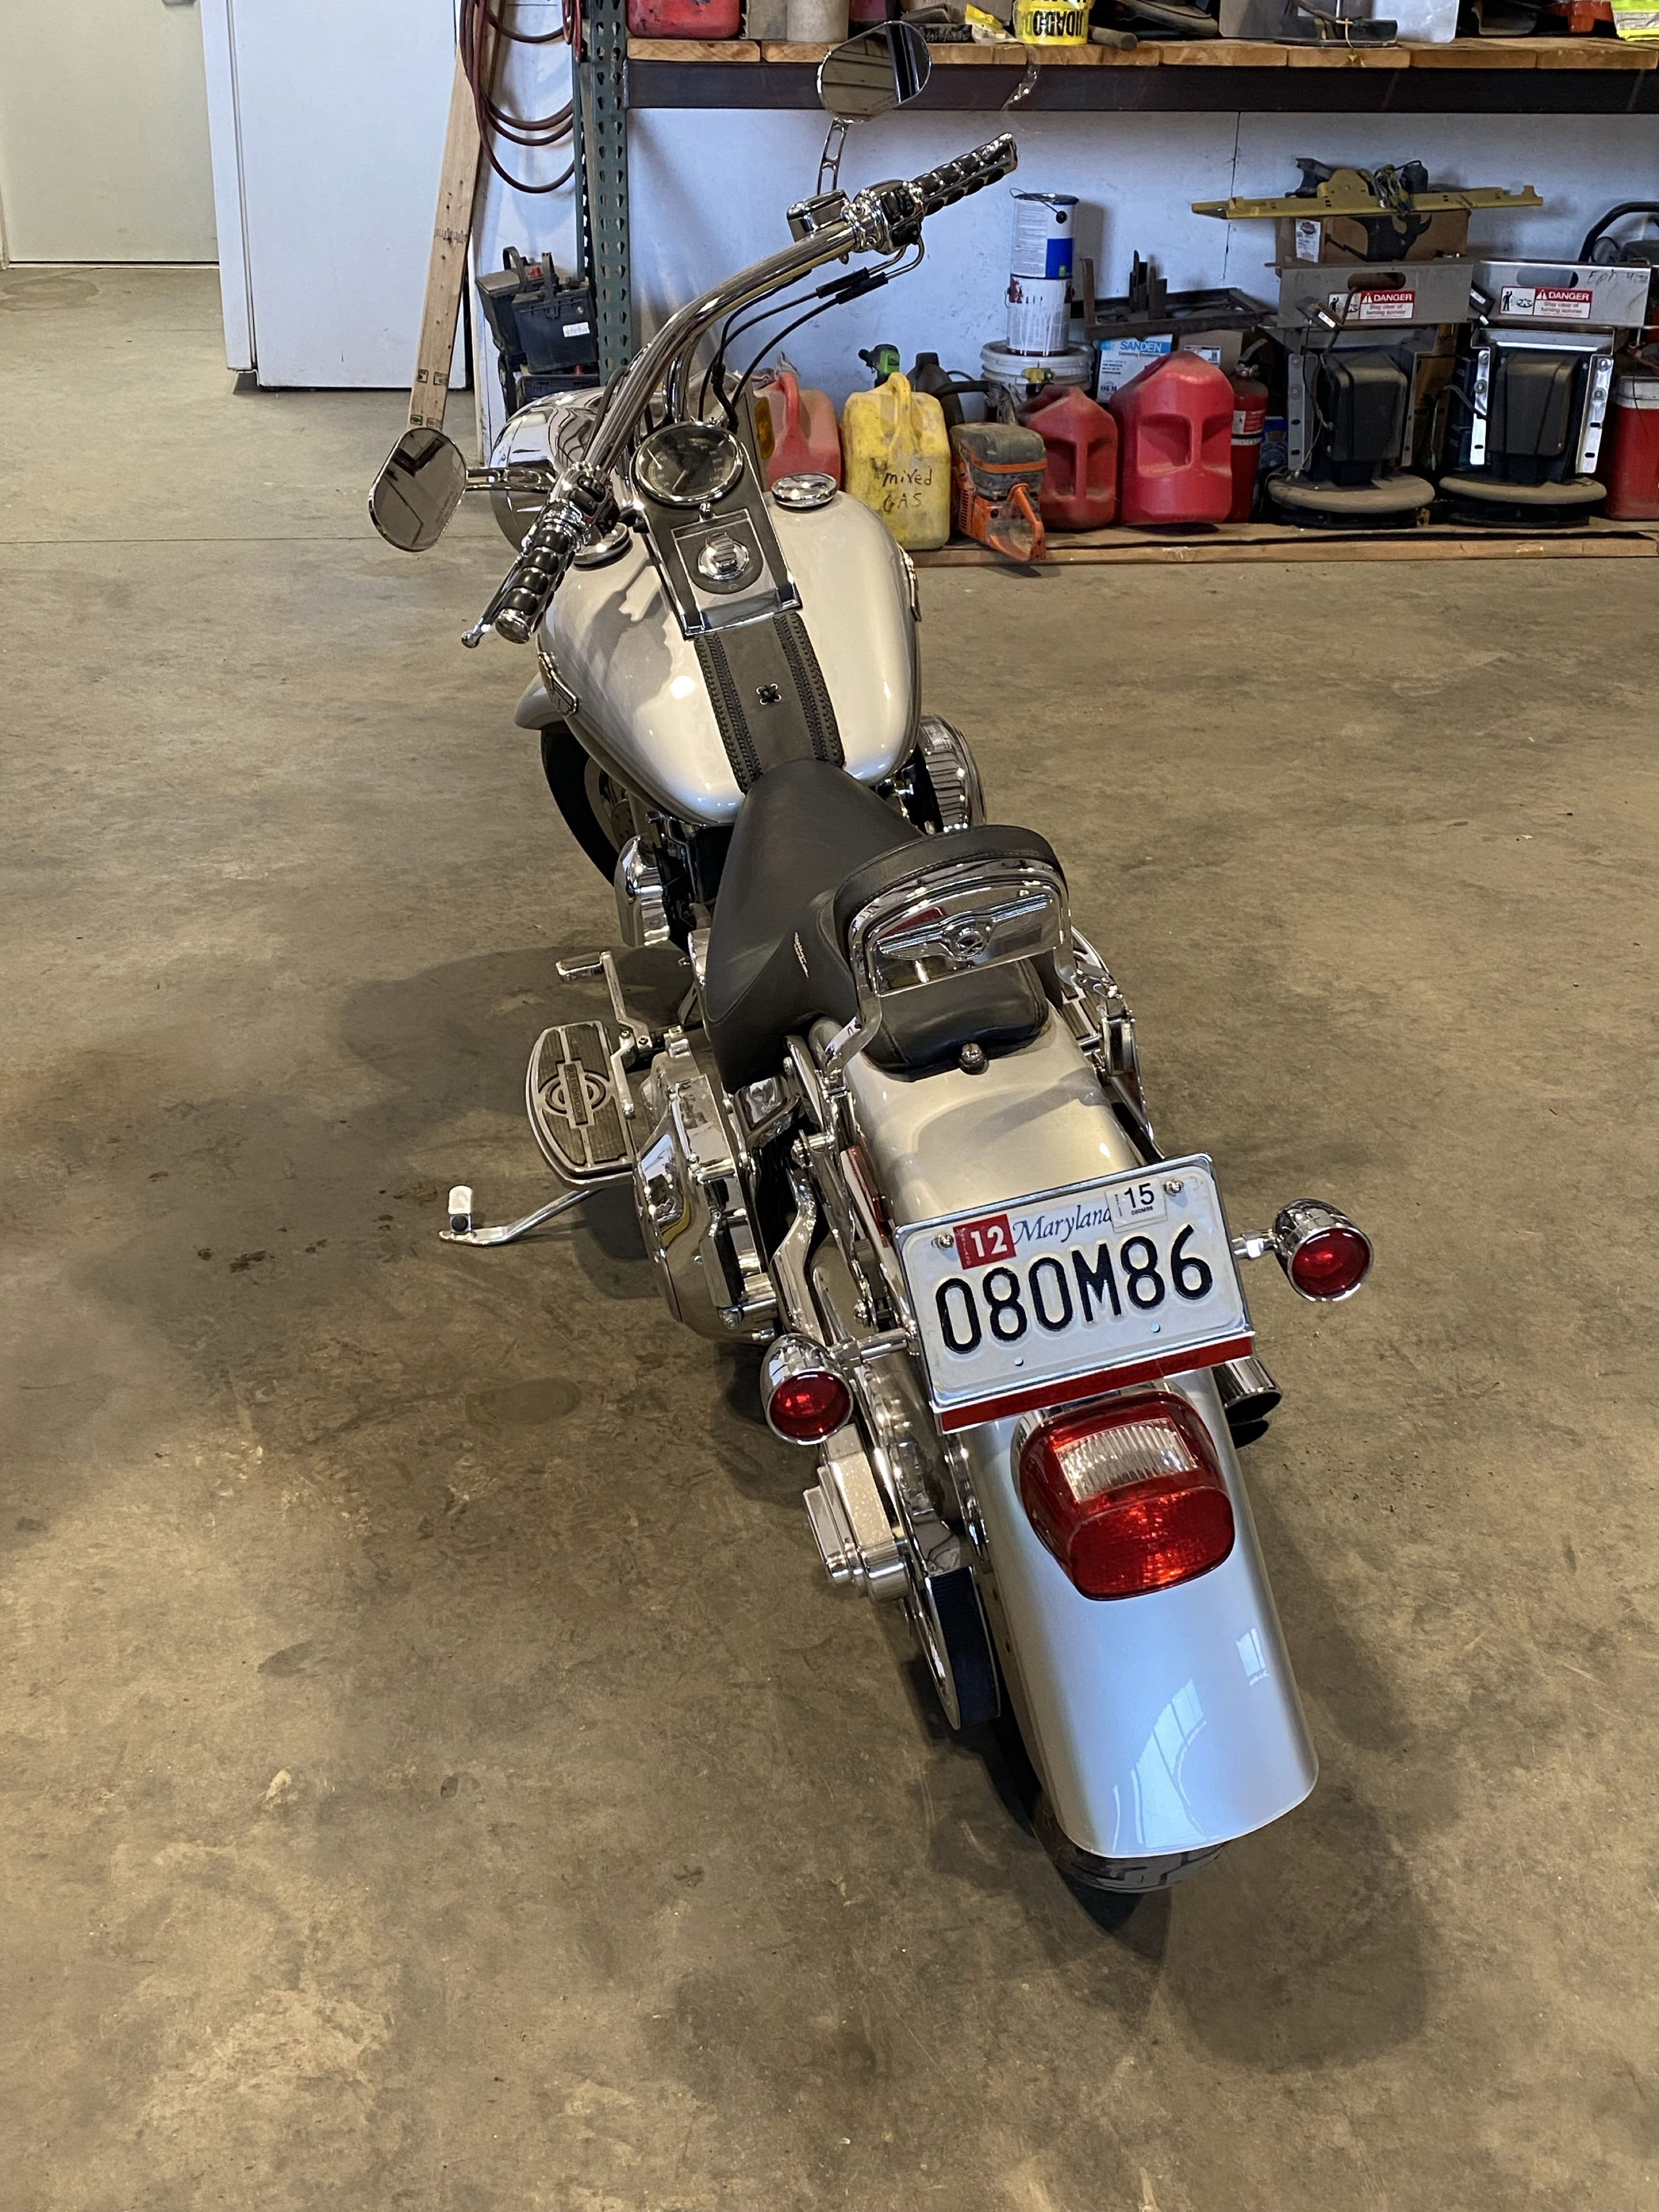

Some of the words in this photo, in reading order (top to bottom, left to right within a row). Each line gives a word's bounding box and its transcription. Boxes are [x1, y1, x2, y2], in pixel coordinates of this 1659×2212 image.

[1373, 294, 1412, 302] DANGER
[1548, 291, 1589, 301] DANGER
[1120, 340, 1162, 353] SANDEN
[882, 468, 932, 487] mixed
[883, 493, 922, 512] GAS
[1124, 1182, 1154, 1208] 15
[971, 1225, 1008, 1257] 12
